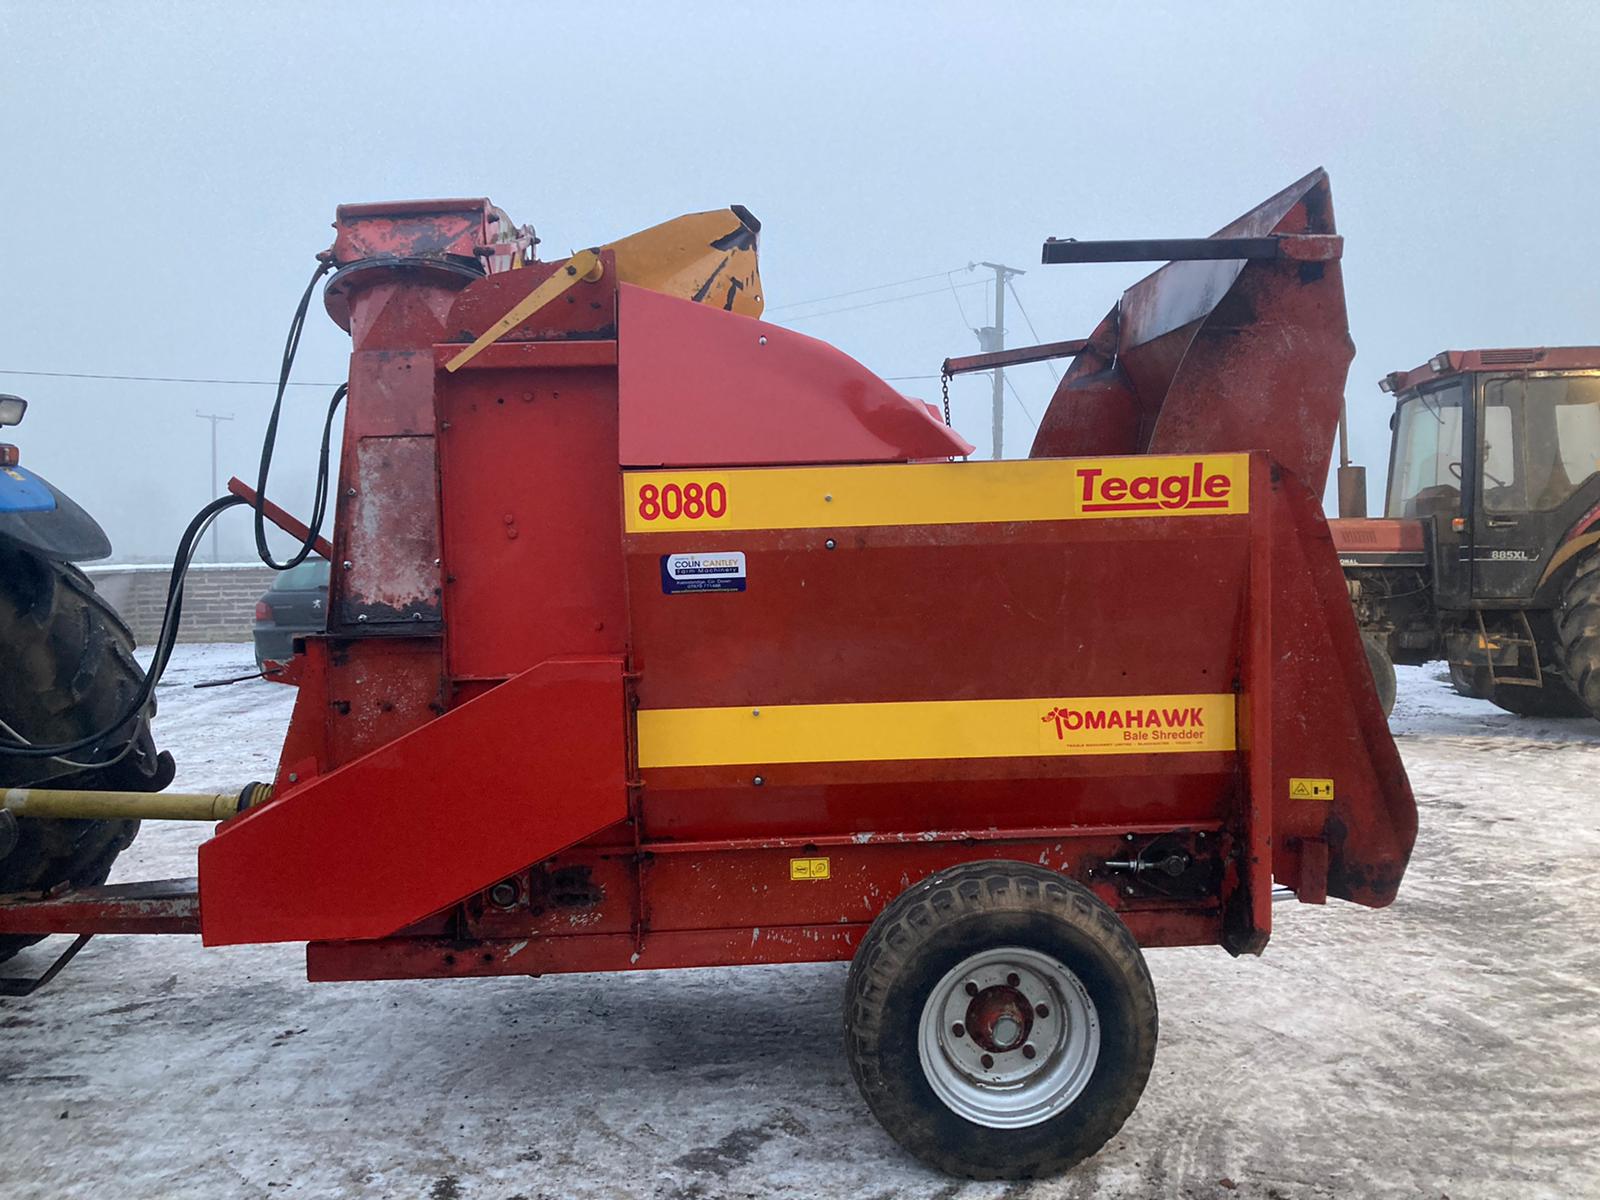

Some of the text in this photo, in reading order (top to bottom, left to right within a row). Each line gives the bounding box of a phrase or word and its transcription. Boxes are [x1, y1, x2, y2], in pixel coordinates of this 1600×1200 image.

[1076, 462, 1231, 509] Teagle
[639, 482, 727, 520] 8080
[1491, 550, 1528, 560] 885XL
[674, 559, 738, 568] COLIN CANTLEY
[1123, 729, 1205, 741] Bale Shredder
